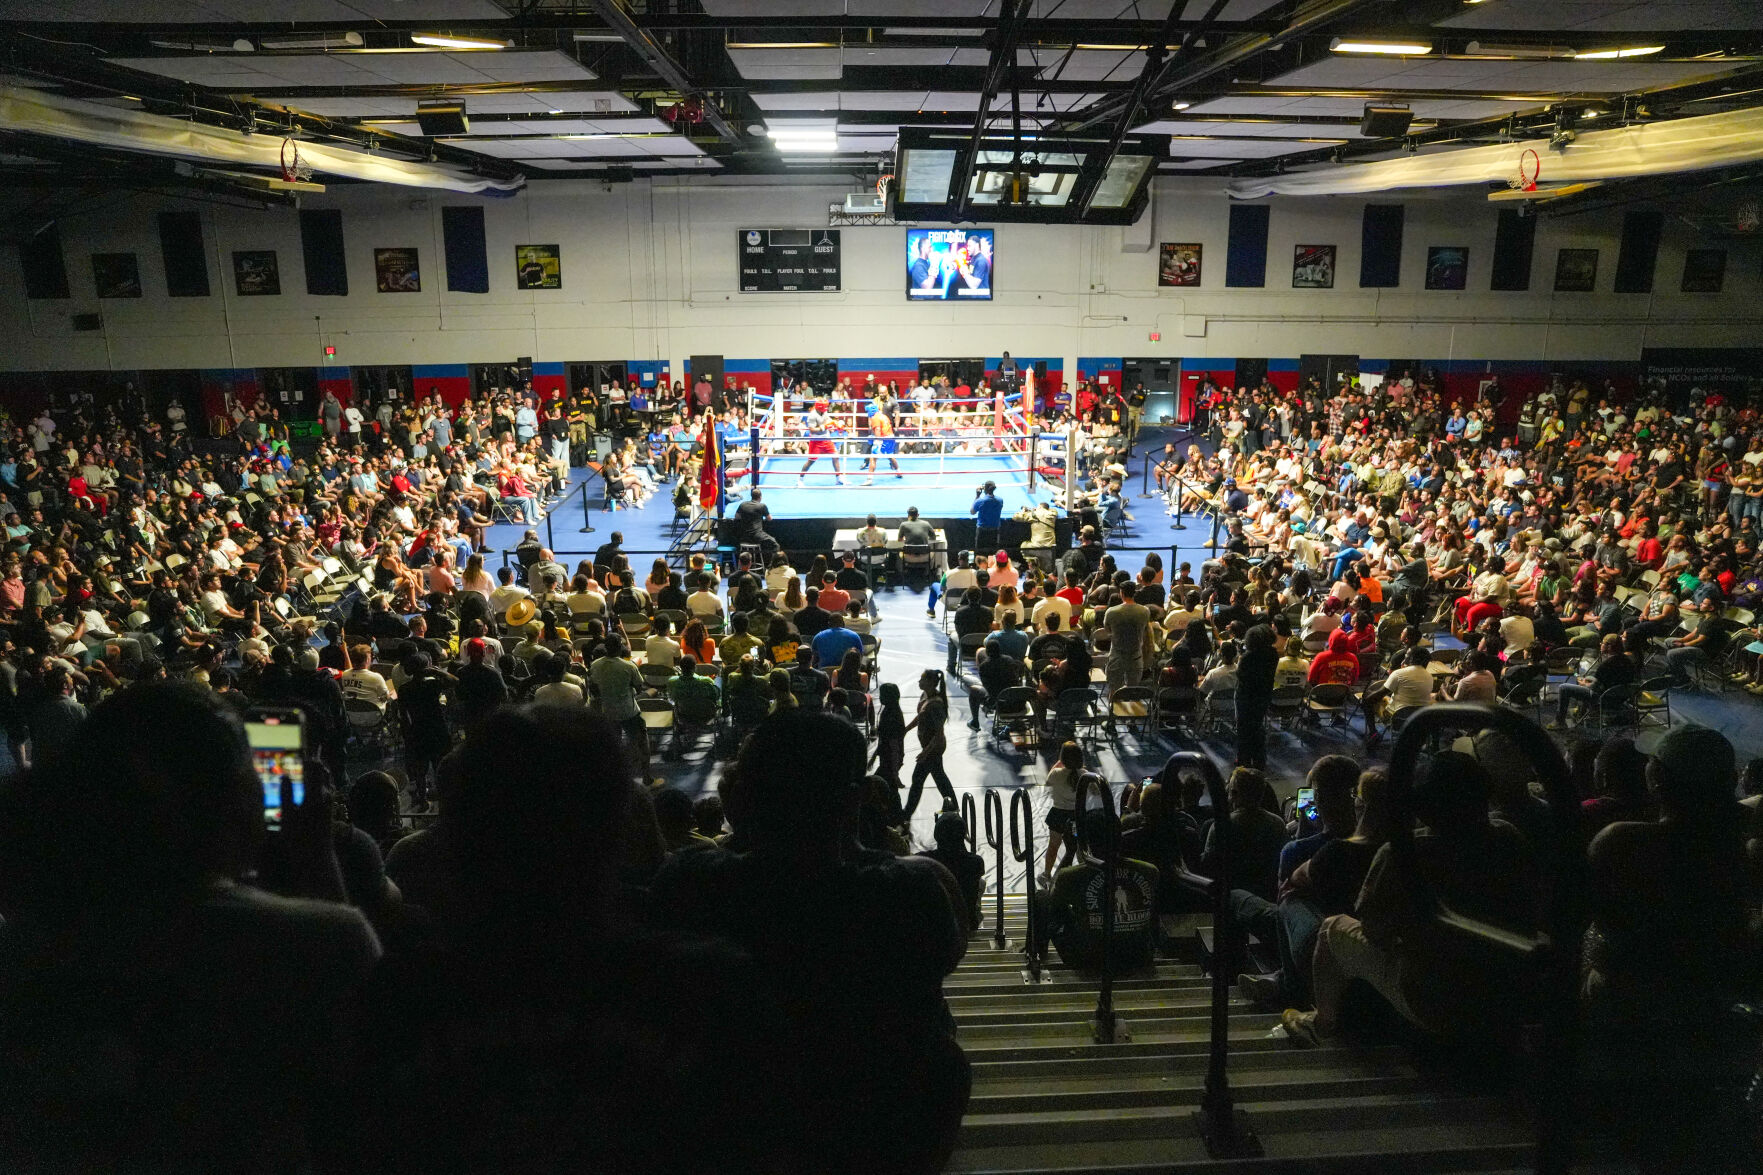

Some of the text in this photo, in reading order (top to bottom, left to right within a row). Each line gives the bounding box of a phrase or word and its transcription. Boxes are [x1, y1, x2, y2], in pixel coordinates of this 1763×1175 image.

[746, 246, 764, 254] HOME
[1647, 365, 1683, 374] Financial
[1684, 366, 1722, 374] resources
[1668, 373, 1691, 382] NCOs
[1692, 374, 1708, 382] and
